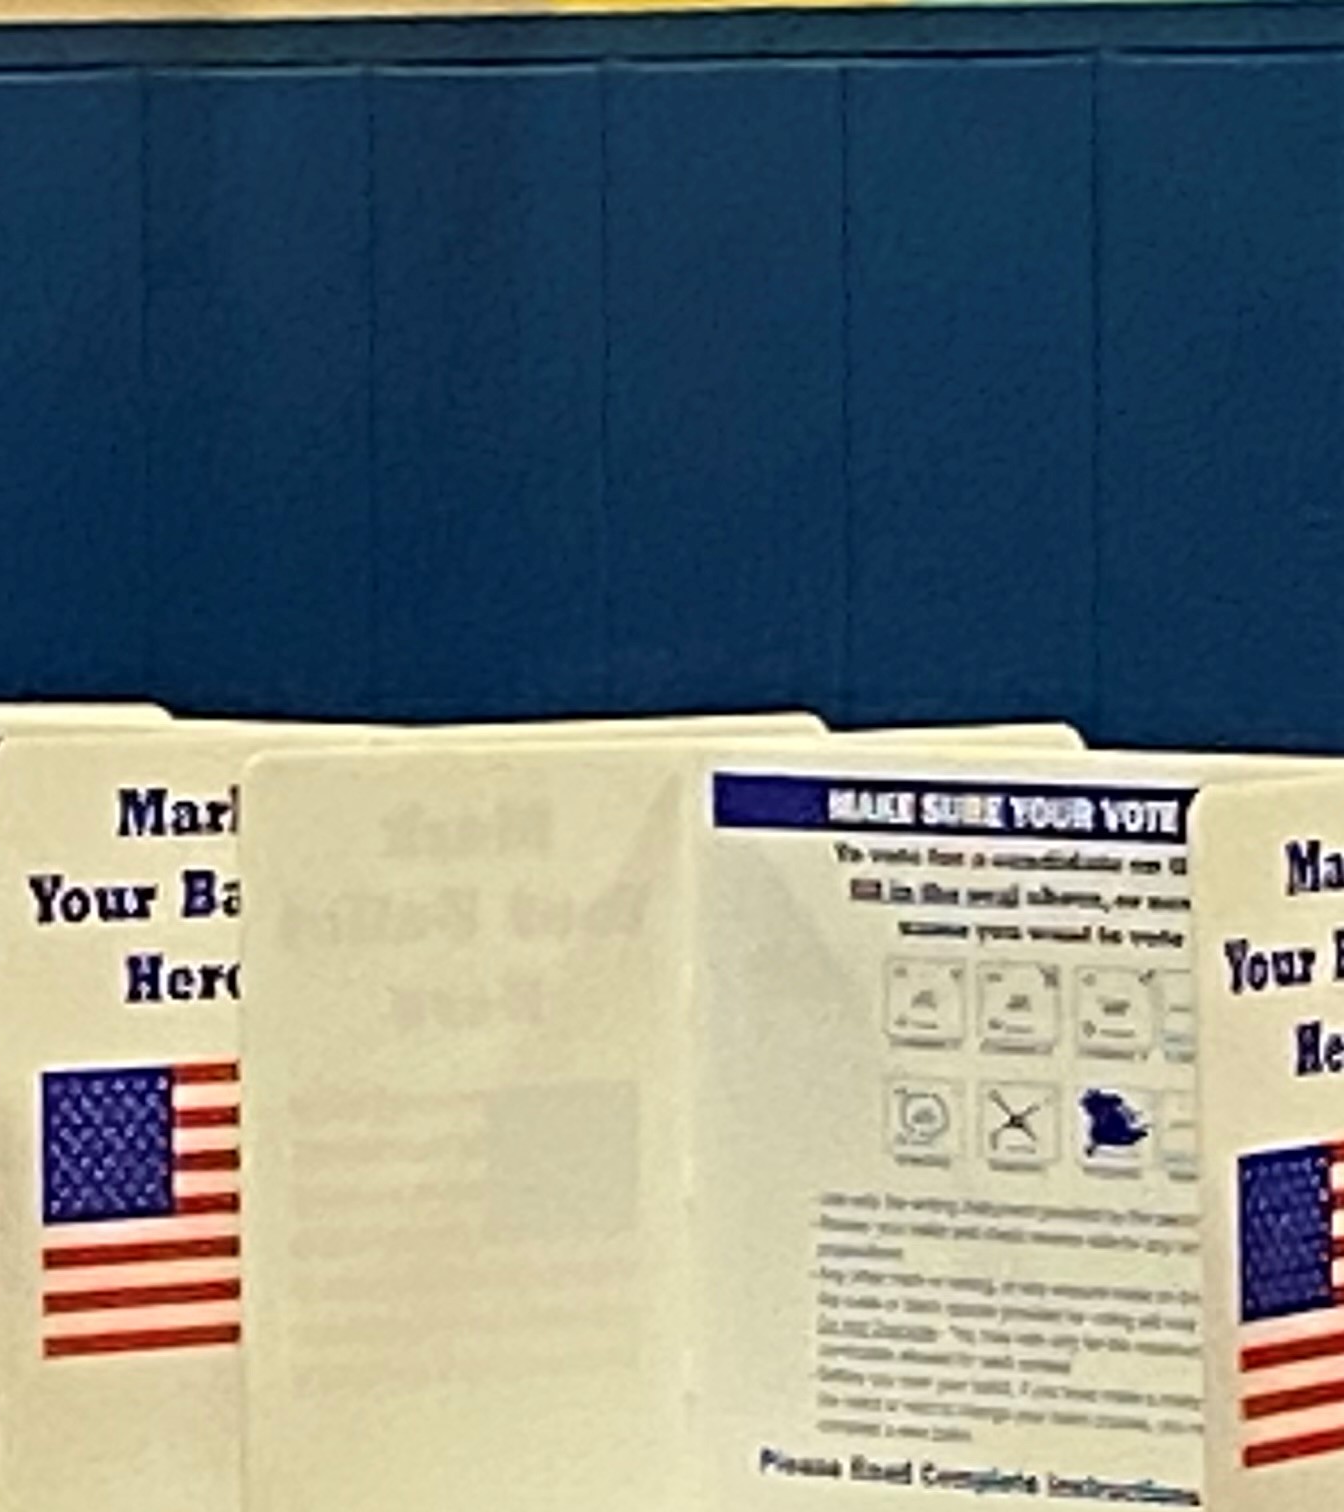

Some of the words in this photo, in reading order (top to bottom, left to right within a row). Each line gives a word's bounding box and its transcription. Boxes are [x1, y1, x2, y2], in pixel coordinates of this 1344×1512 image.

[1100, 796, 1179, 835] VOTE
[28, 873, 159, 925] Your
[1224, 937, 1316, 995] Your
